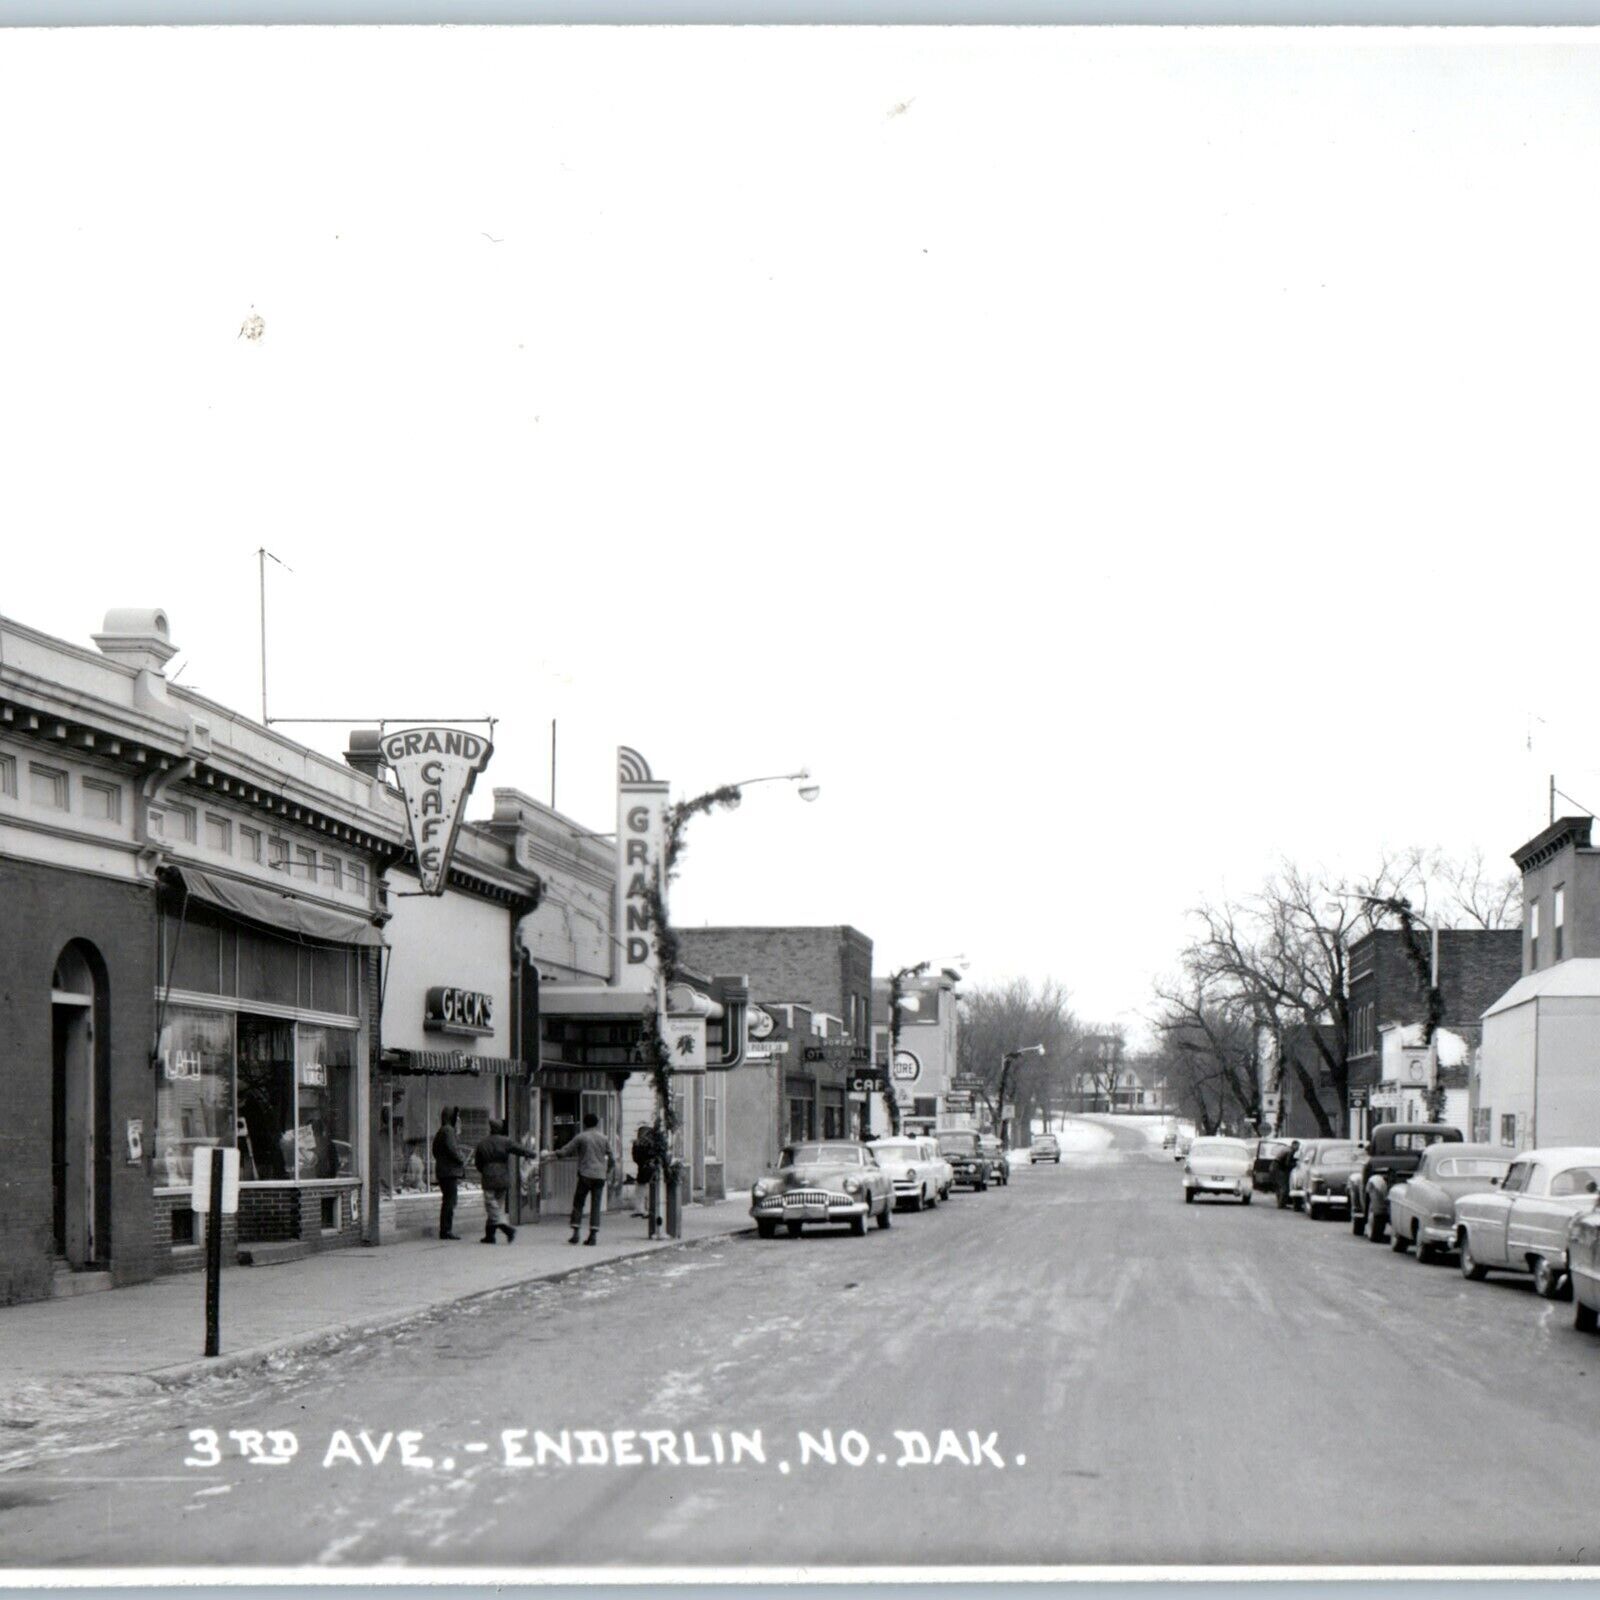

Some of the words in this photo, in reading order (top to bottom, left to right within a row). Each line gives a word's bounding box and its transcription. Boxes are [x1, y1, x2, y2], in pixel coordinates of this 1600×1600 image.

[386, 731, 481, 760] GRAND
[420, 760, 442, 872] CAFE
[625, 806, 651, 965] GRAND
[853, 1078, 883, 1091] CAF
